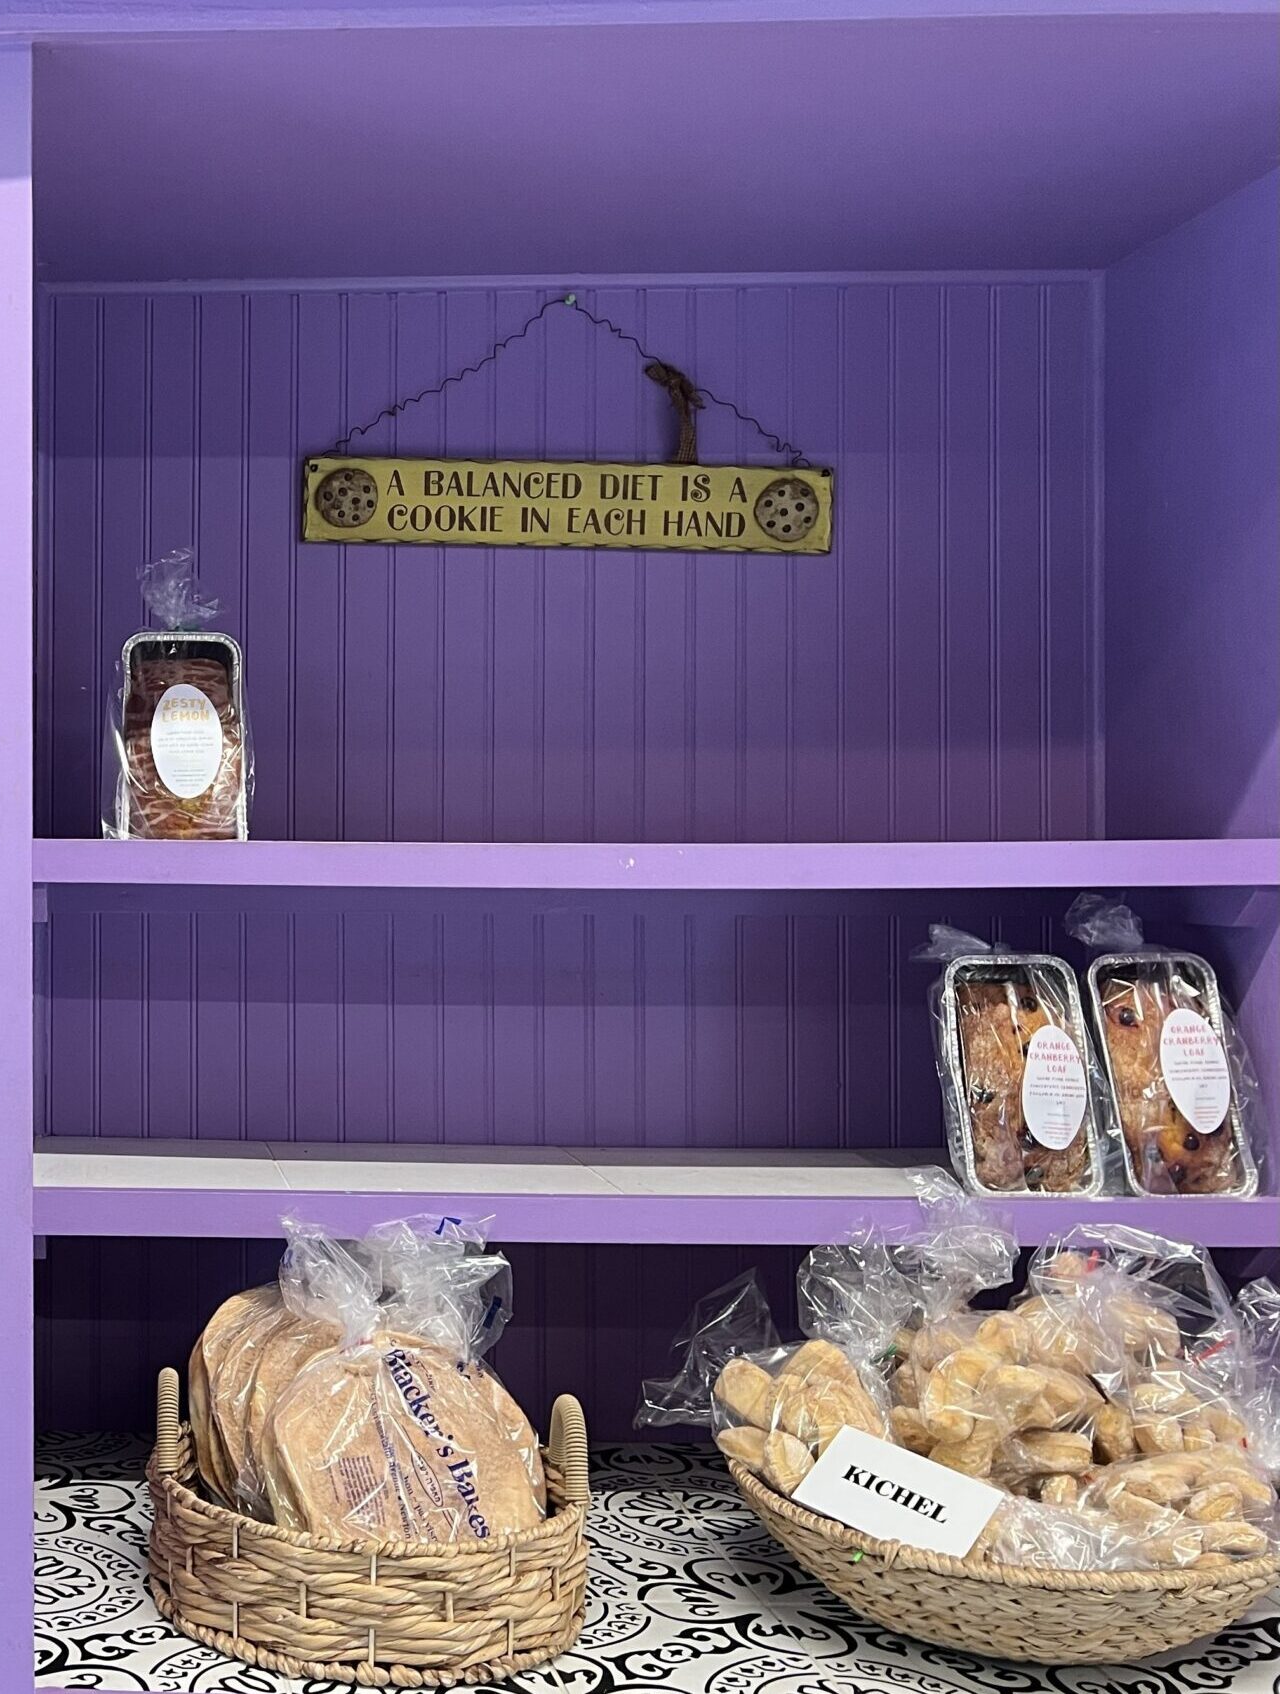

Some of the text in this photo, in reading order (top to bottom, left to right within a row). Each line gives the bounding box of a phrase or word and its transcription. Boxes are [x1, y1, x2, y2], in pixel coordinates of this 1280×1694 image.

[387, 470, 748, 503] A BALANCED DIET IS A
[387, 504, 746, 538] COOKIE IN EACH HAND
[162, 697, 207, 711] ZESTY
[161, 710, 210, 723] LEMON
[1170, 1024, 1207, 1034] ORANGE
[1036, 1041, 1071, 1051] ORANGE
[1163, 1036, 1219, 1046] CRANBERRY
[1029, 1052, 1081, 1064] CRANBERRY
[1183, 1047, 1205, 1057] LOAF
[1046, 1064, 1067, 1074] LOAF
[384, 1348, 455, 1458] Blacker's
[841, 1463, 950, 1525] KICHEL
[399, 1502, 412, 1540] Newton
